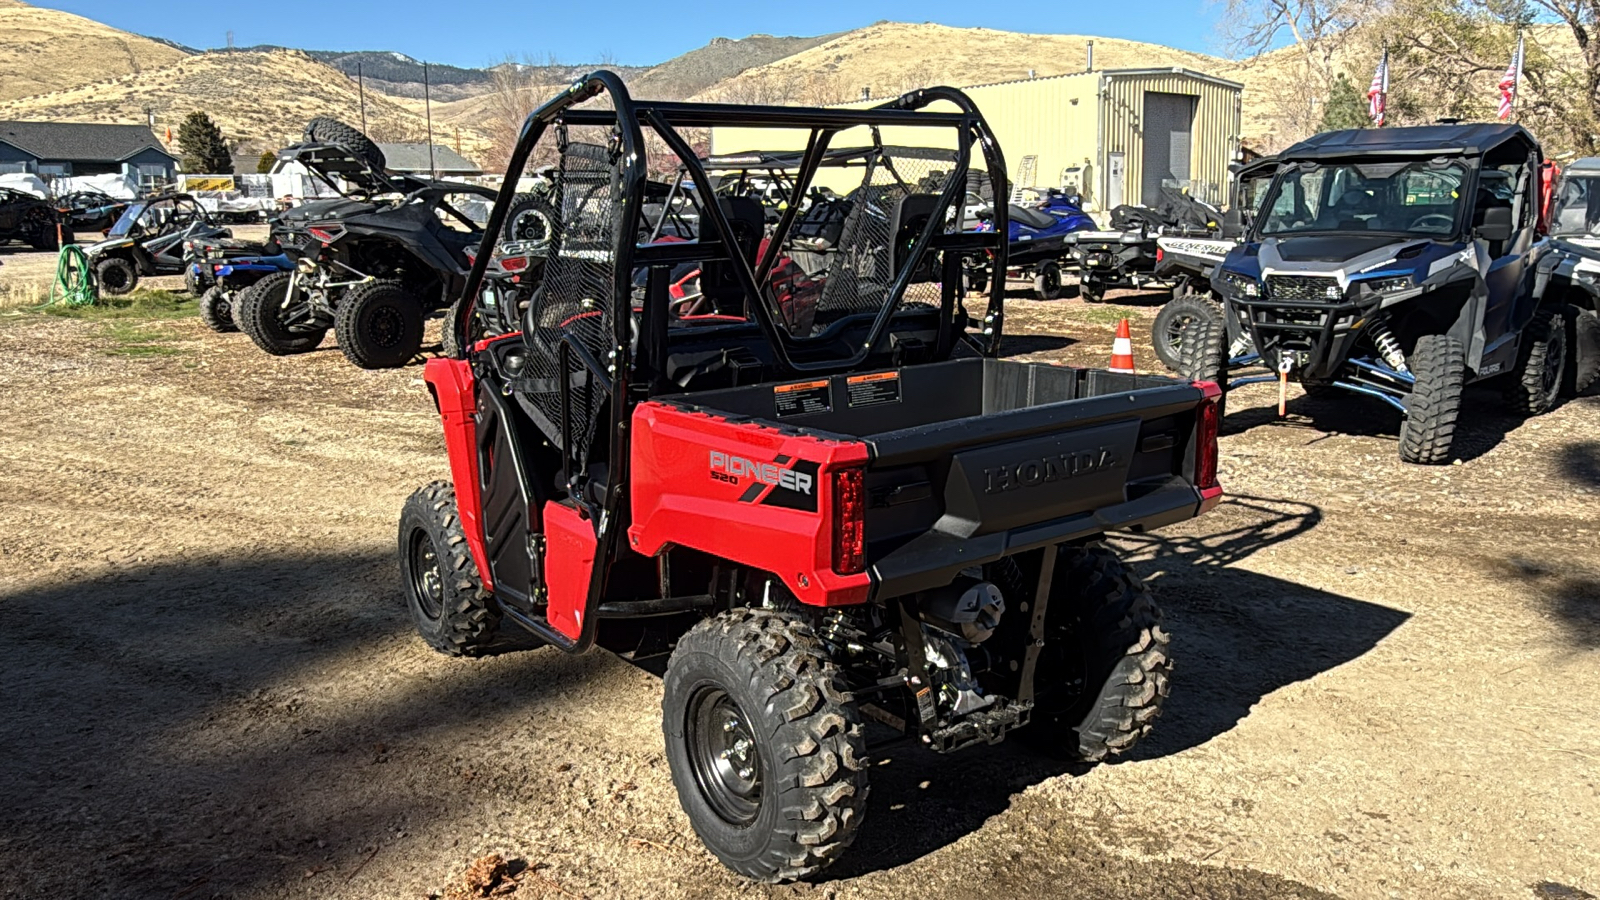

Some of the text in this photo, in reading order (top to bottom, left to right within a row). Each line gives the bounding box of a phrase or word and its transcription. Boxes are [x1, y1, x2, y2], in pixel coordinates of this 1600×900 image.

[710, 451, 811, 495] PIONEER
[710, 470, 739, 486] 520
[984, 446, 1119, 493] HONDA
